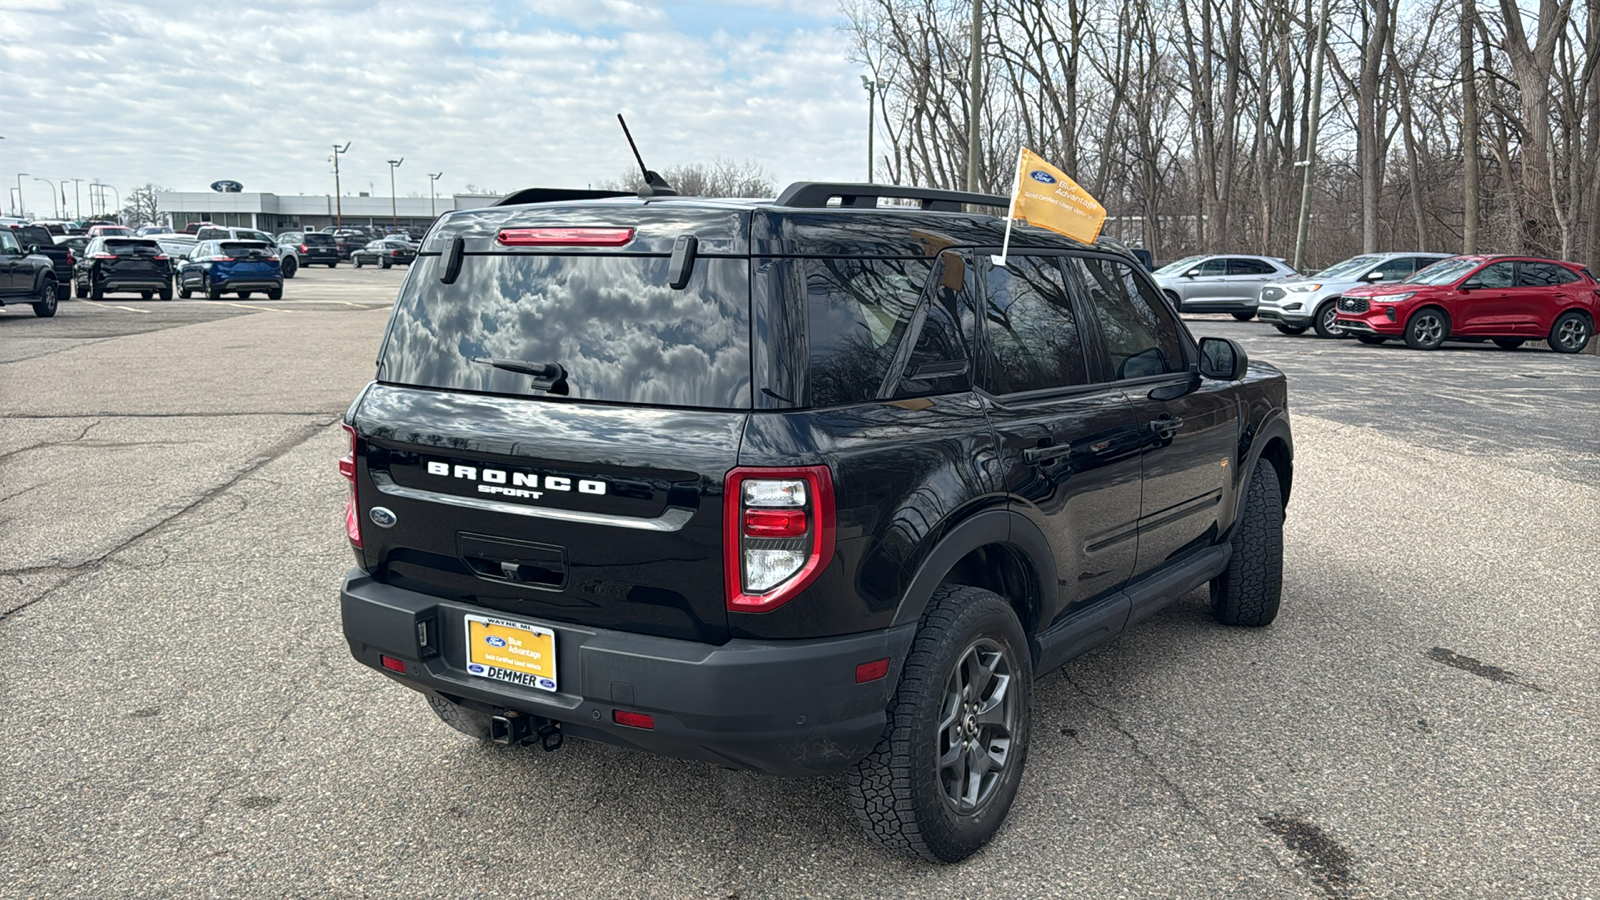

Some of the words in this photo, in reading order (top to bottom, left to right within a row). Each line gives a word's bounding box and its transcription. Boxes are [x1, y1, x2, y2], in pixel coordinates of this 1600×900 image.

[1058, 180, 1077, 192] Blue
[1024, 191, 1039, 199] Gold
[1055, 188, 1097, 210] Advantage
[427, 461, 606, 495] BRONCO
[477, 484, 544, 499] SPORT
[507, 636, 523, 647] Blue
[508, 645, 542, 660] Advantage
[484, 653, 496, 661] Gold
[495, 655, 514, 665] Certified
[514, 659, 526, 667] Used
[526, 661, 542, 671] Vehicle
[487, 666, 537, 686] DEMMER
